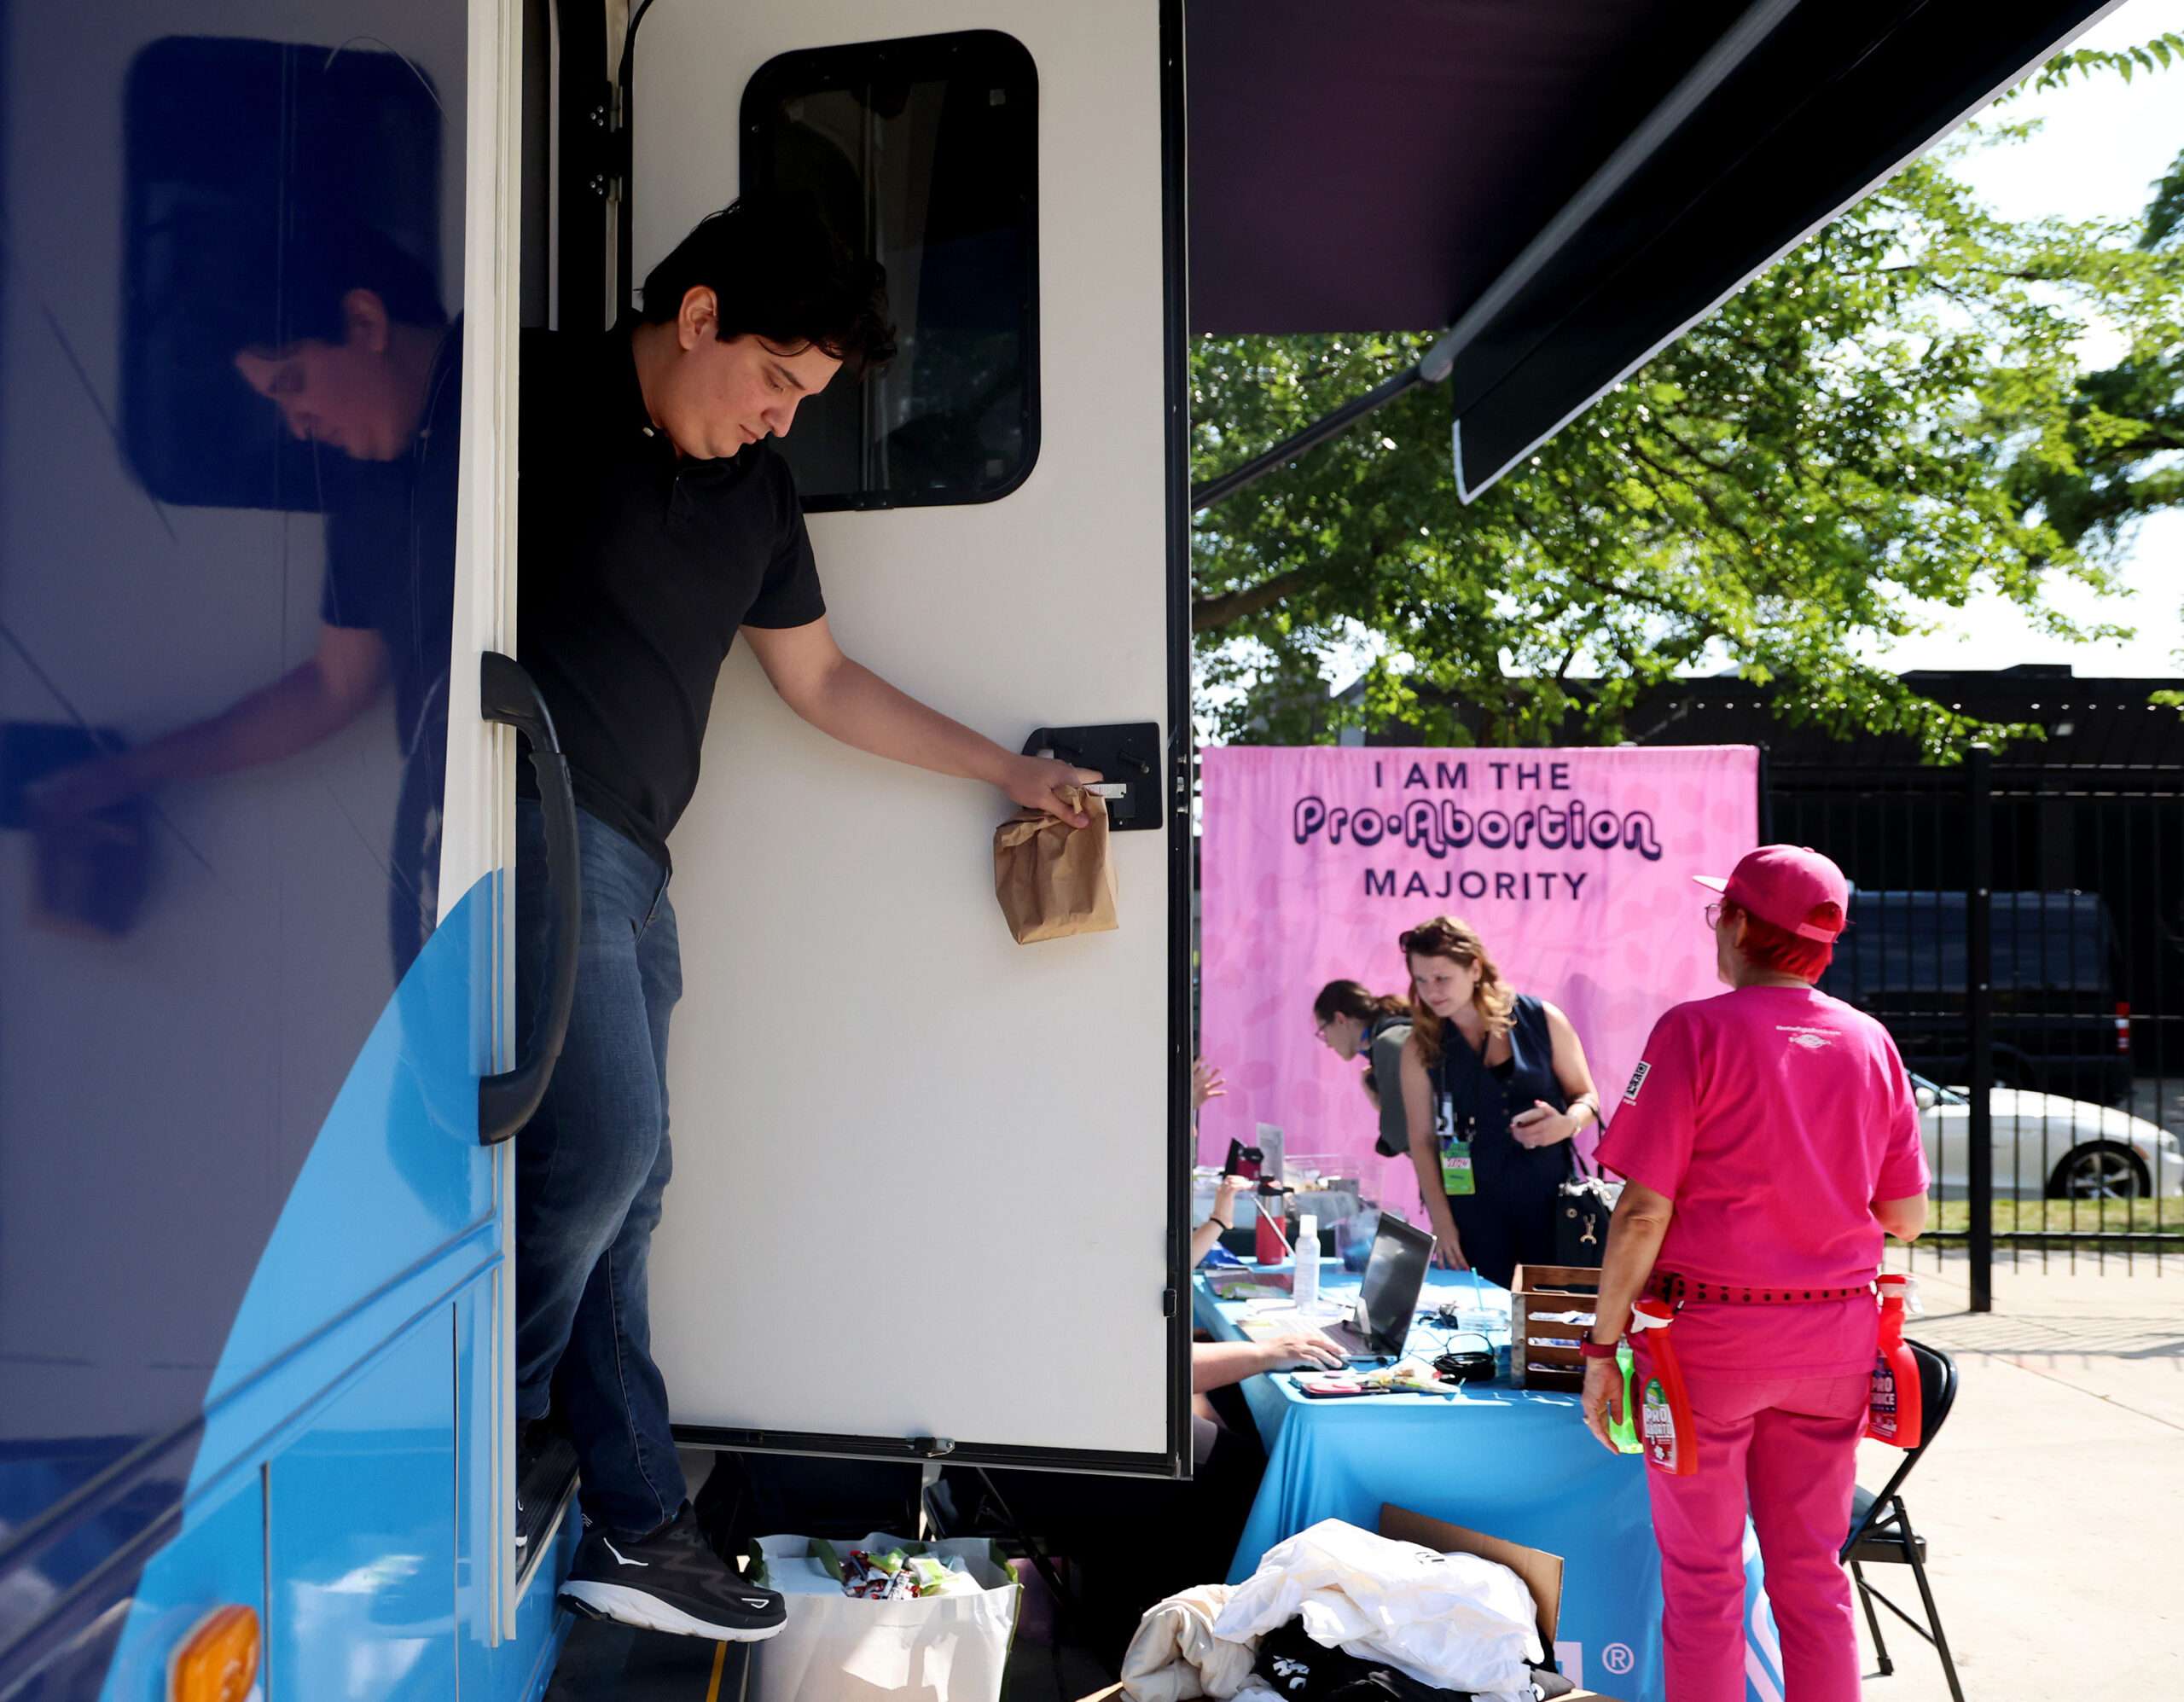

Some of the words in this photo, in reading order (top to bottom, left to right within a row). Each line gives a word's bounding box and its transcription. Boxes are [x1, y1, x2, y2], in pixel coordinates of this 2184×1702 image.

[1374, 760, 1382, 788] I
[1403, 761, 1468, 789] AM
[1489, 762, 1571, 791] THE
[1364, 868, 1588, 901] MAJORITY
